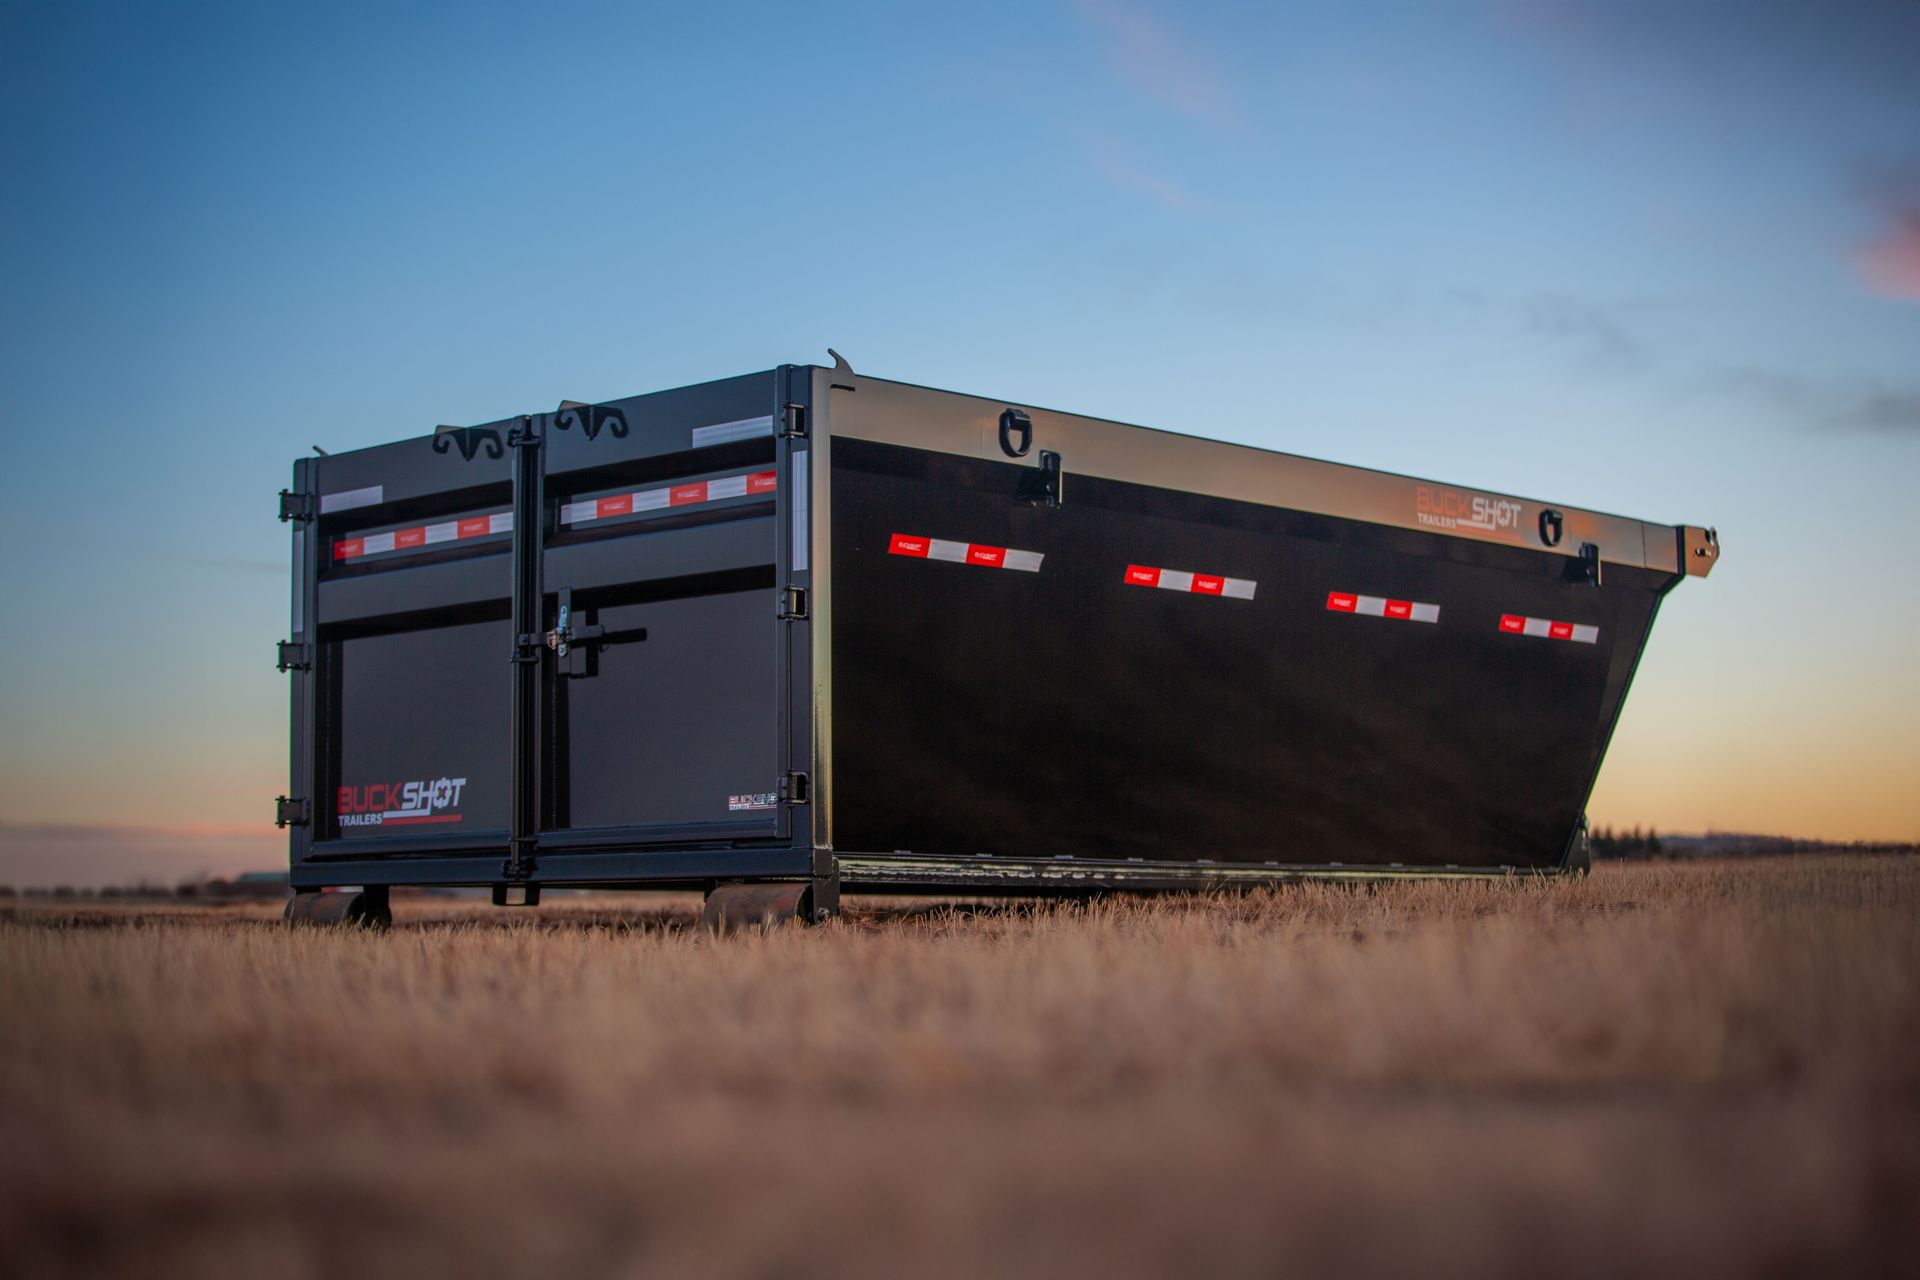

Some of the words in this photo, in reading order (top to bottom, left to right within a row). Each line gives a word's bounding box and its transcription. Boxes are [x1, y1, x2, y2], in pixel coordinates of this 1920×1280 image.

[1416, 485, 1522, 530] BUCKSHOT
[1417, 512, 1457, 529] TRAILERS
[337, 777, 467, 815] BUCKSHOT
[338, 813, 383, 827] TRAILERS
